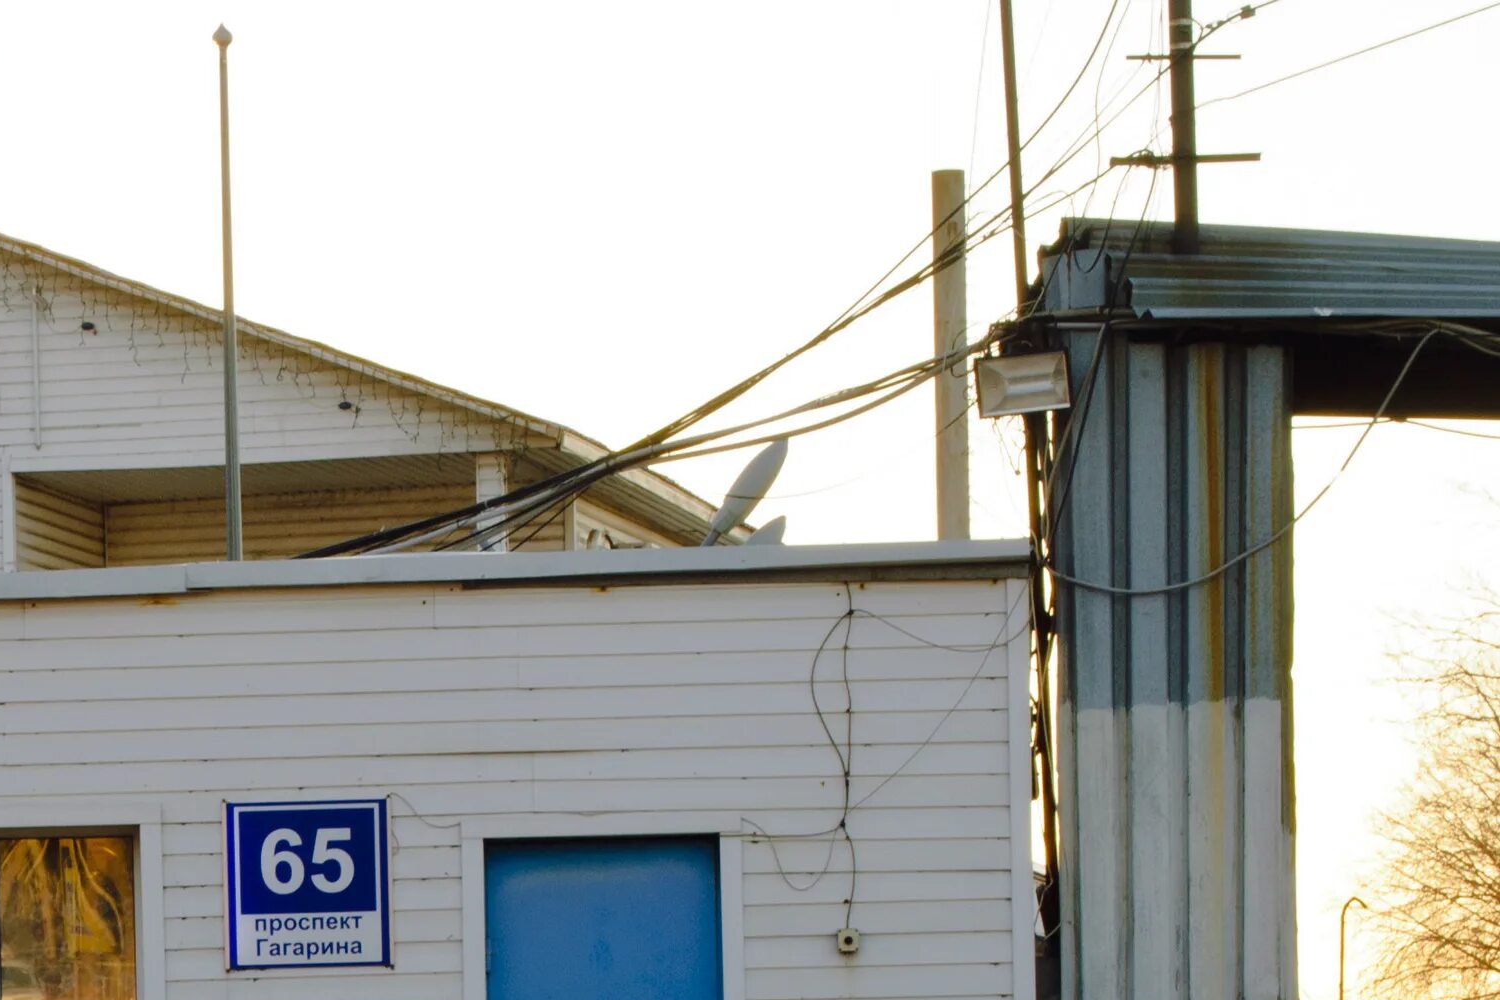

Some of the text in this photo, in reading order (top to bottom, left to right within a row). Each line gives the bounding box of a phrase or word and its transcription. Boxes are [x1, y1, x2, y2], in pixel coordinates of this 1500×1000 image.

[260, 827, 355, 895] 65
[255, 916, 362, 935] проспект
[256, 939, 362, 959] Гагарина
